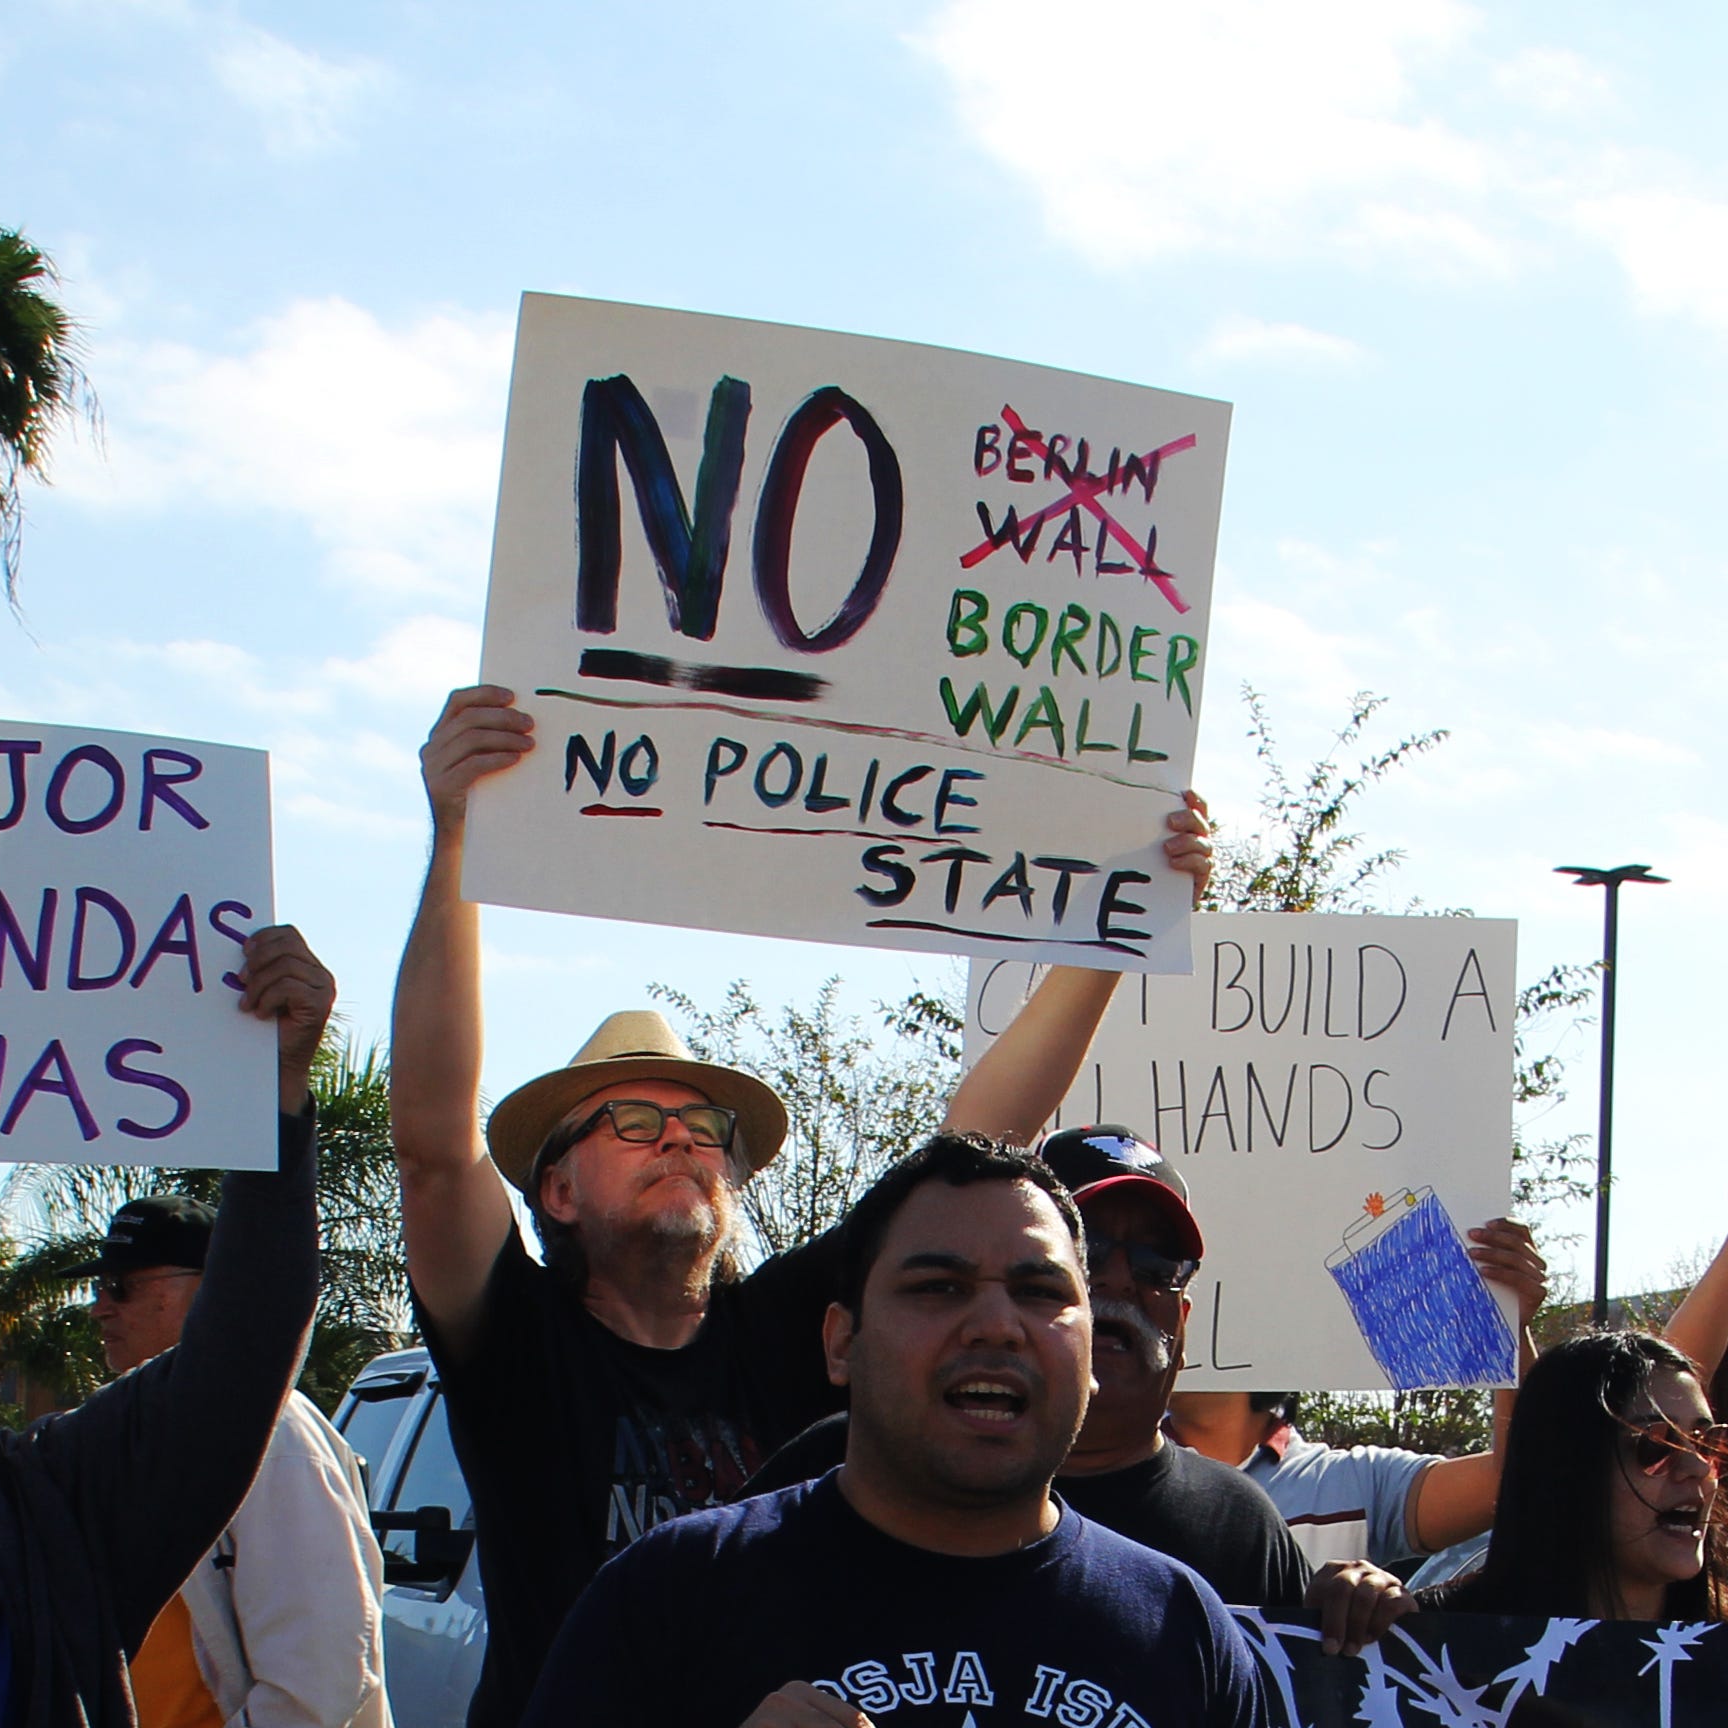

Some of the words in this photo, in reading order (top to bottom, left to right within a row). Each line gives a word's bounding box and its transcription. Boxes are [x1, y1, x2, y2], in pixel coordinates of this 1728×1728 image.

[972, 424, 1163, 503] BERLIN
[574, 373, 904, 655] NO
[976, 501, 1176, 581] WALL
[947, 587, 1200, 718] BORDER
[939, 677, 1169, 765] WALL
[564, 729, 660, 798] NO
[703, 736, 987, 835] POLICE
[854, 844, 1154, 943] STATE
[1212, 941, 1408, 1040] BUILD
[1440, 947, 1496, 1041] A
[1152, 1060, 1403, 1155] HANDS
